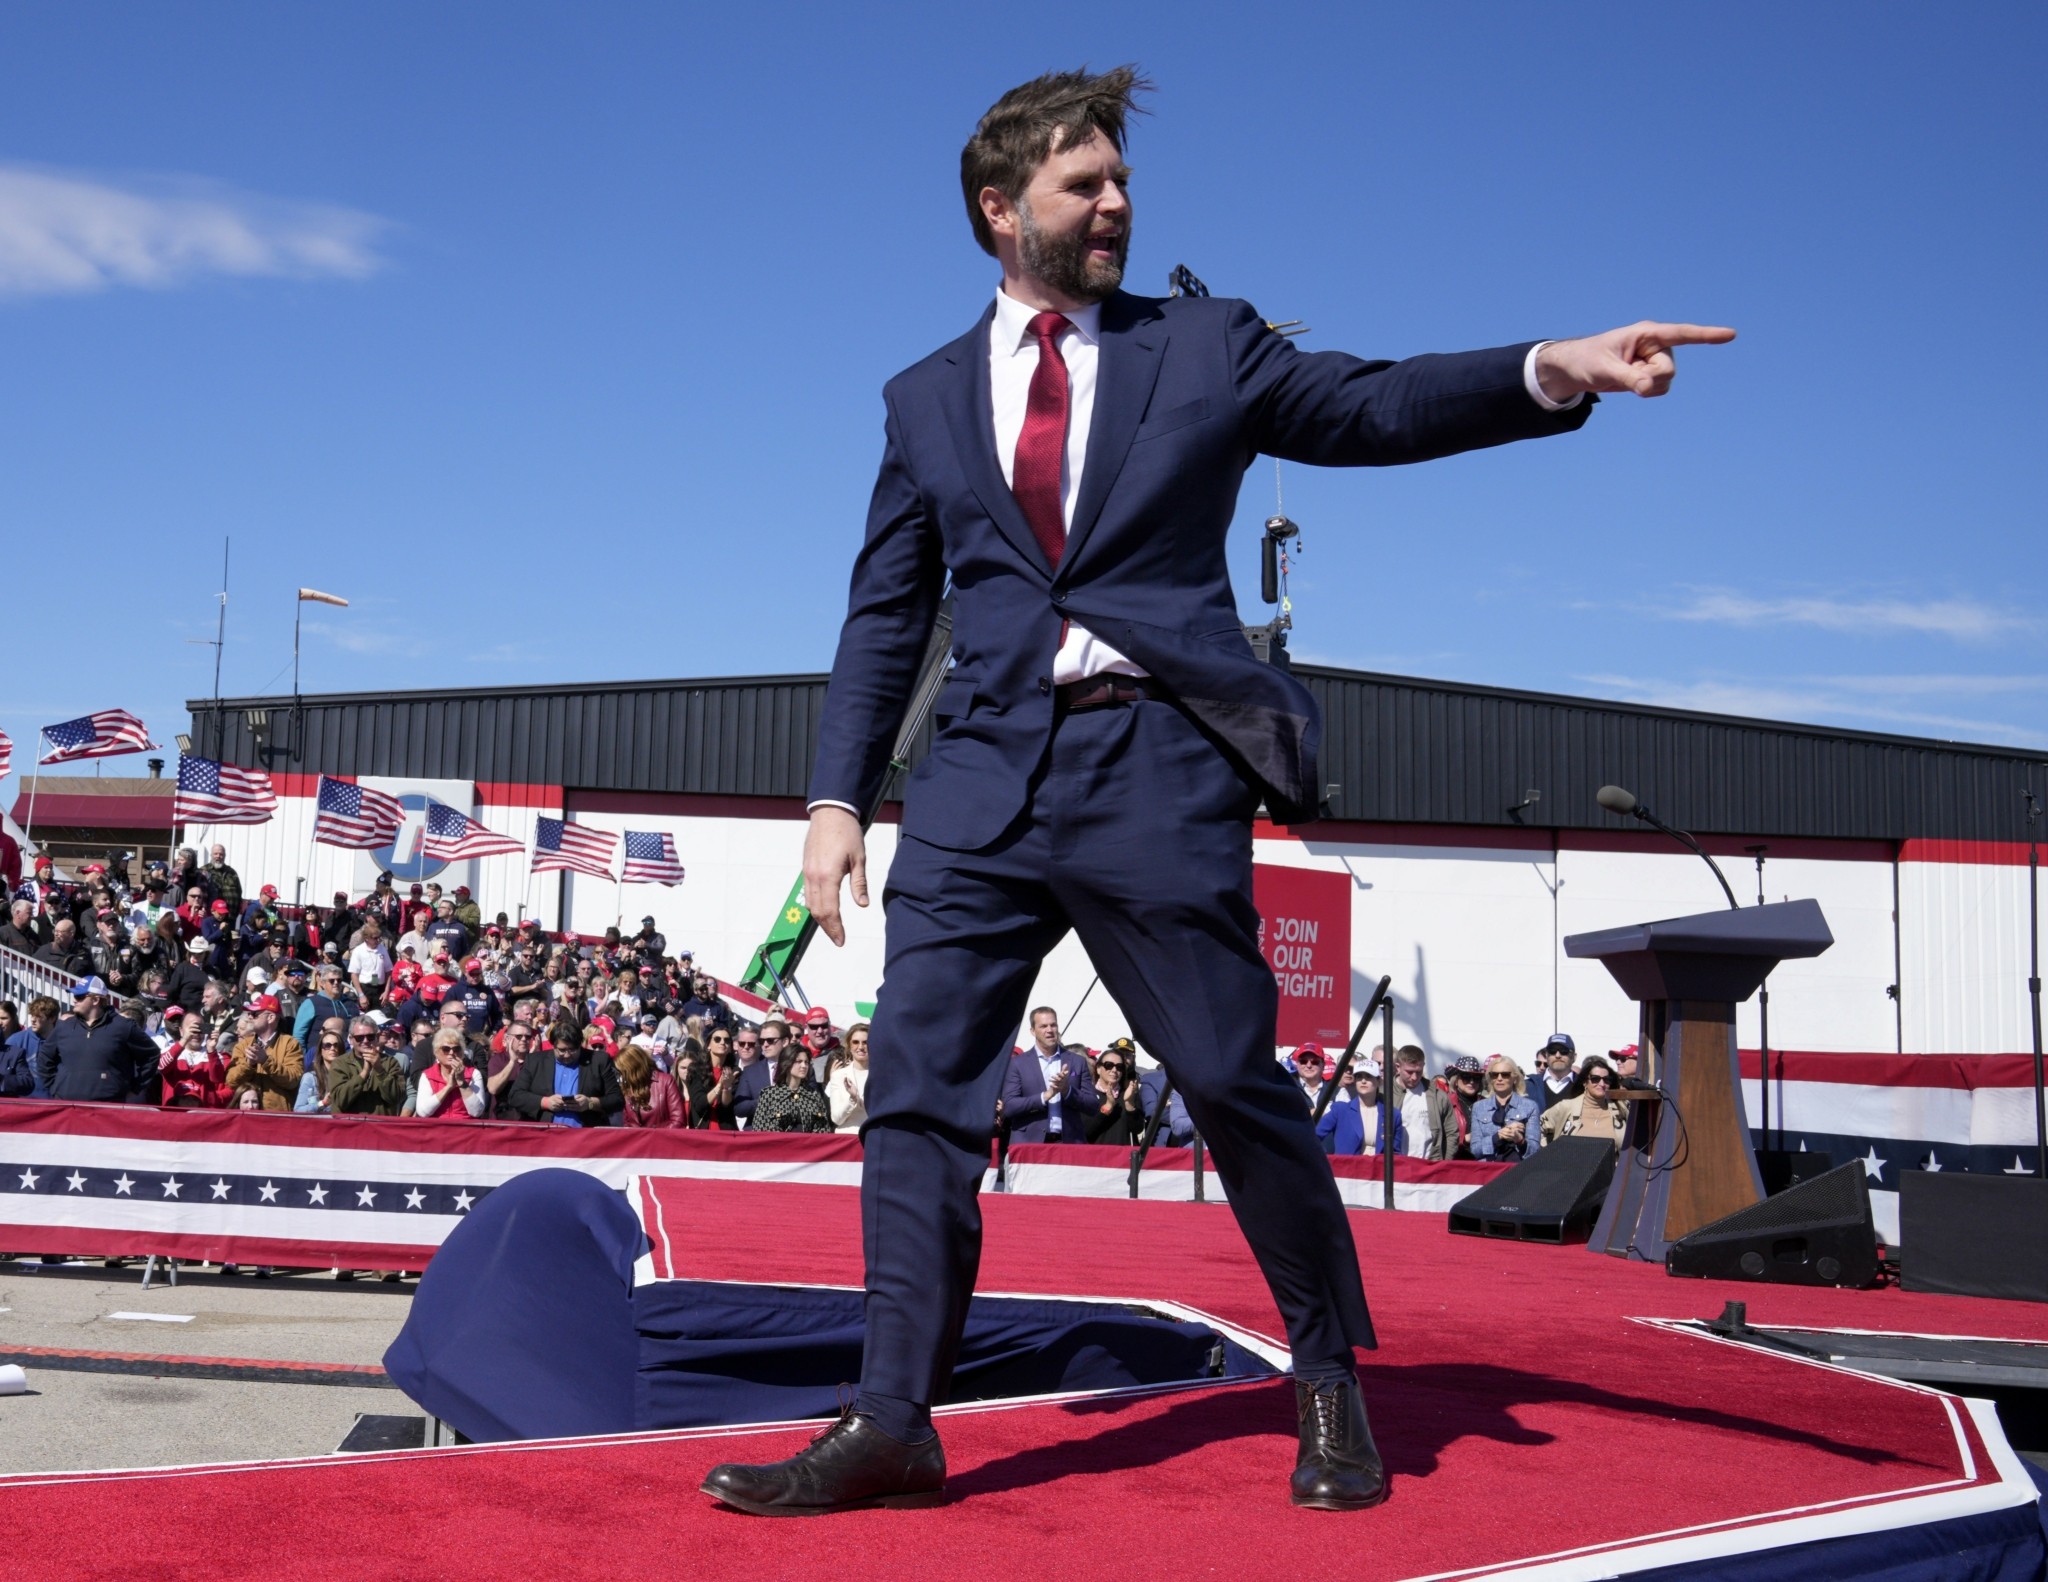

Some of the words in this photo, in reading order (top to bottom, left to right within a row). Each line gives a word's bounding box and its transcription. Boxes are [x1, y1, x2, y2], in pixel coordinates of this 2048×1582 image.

[1273, 917, 1319, 943] JOIN
[1273, 945, 1313, 970] OUR
[1274, 972, 1334, 999] FIGHT!
